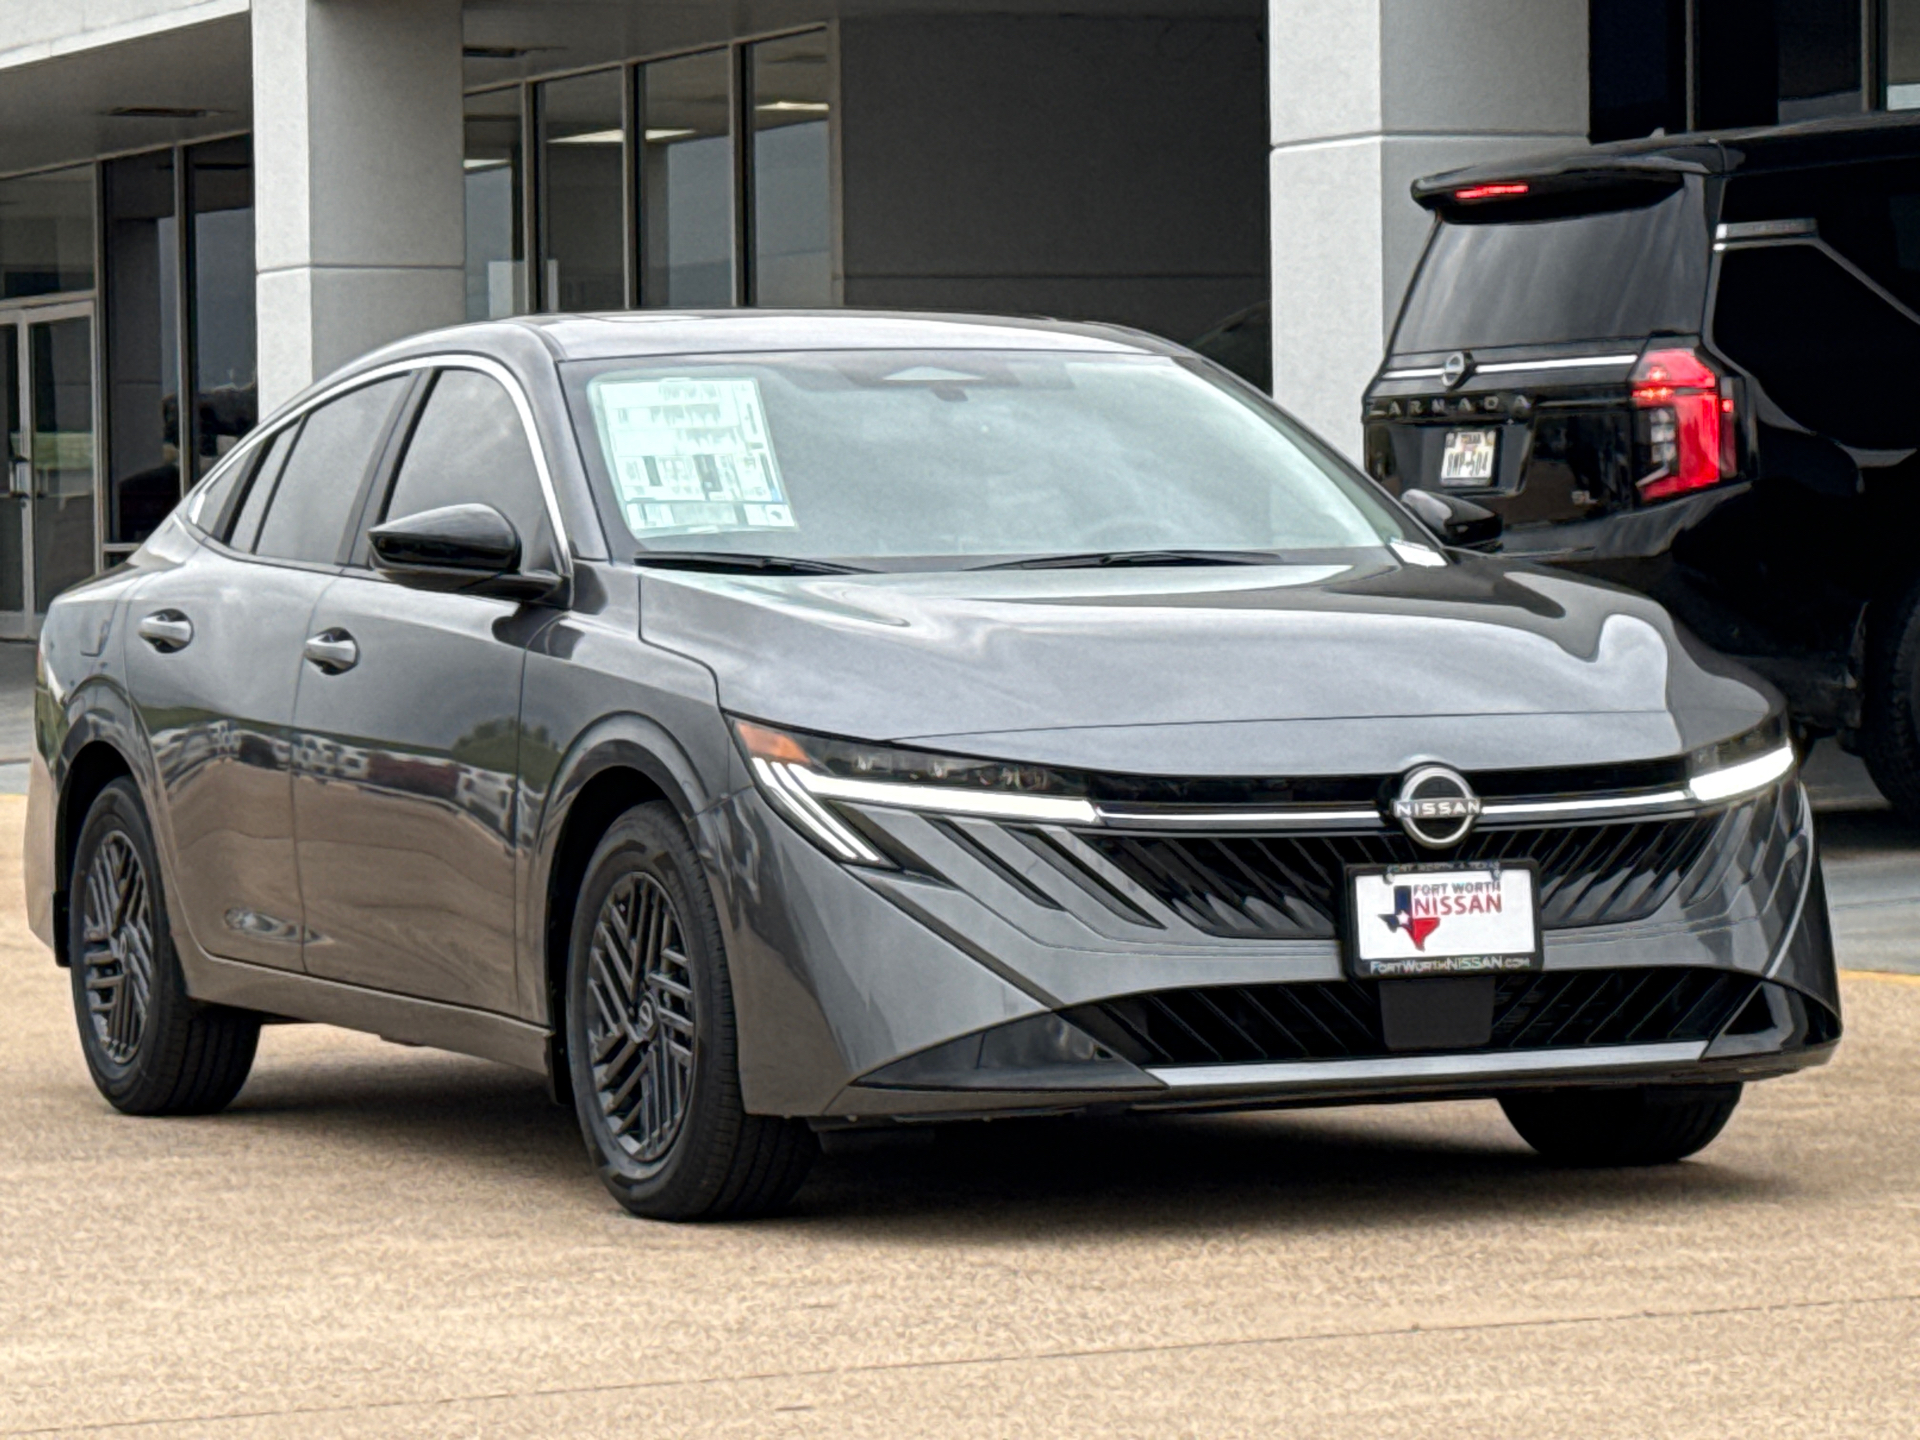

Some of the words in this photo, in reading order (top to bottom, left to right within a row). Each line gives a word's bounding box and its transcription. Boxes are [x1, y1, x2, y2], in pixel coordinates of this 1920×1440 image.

[1394, 800, 1481, 817] NISSAN
[1413, 883, 1449, 896] FORT
[1451, 881, 1501, 894] WORTH
[1414, 894, 1502, 916] NISSAN
